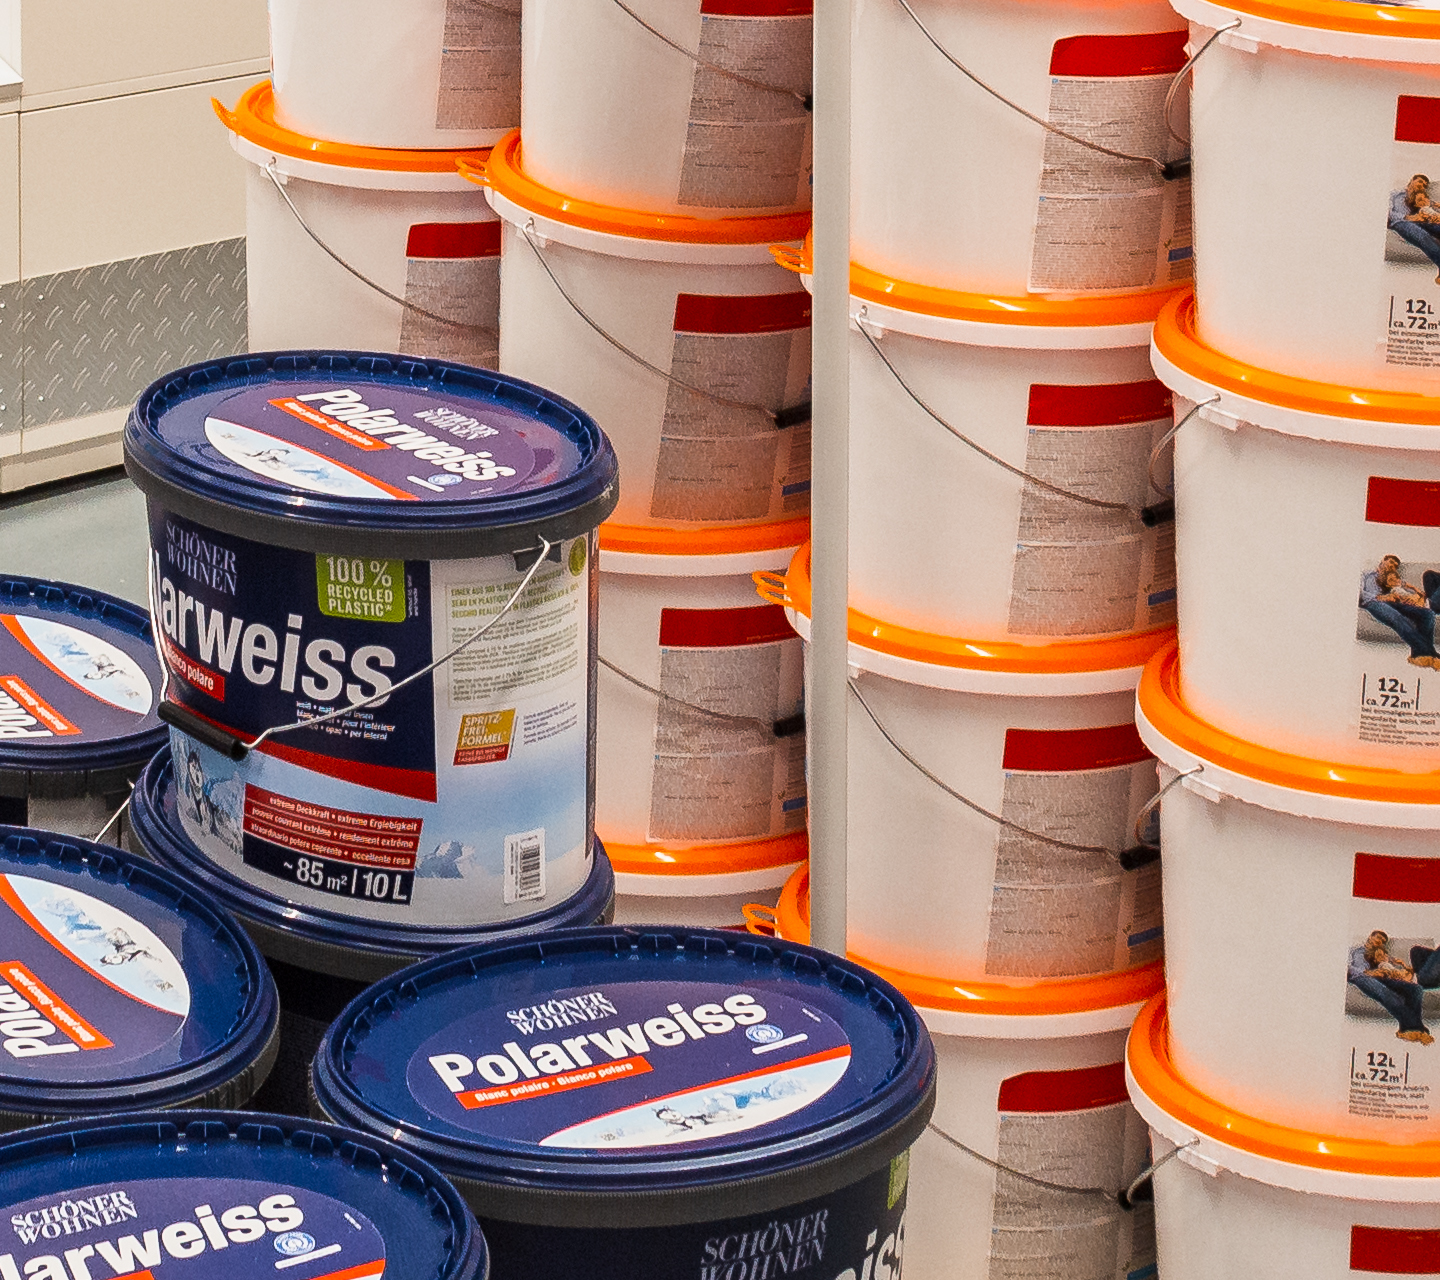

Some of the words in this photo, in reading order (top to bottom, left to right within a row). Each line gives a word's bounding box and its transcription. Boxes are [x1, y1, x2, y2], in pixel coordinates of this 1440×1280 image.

[296, 387, 516, 486] Polarweiss
[325, 555, 364, 585] 100
[327, 584, 393, 603] RECYCLED
[505, 991, 612, 1026] SCHÖNER
[512, 999, 619, 1037] WOHNEN
[426, 992, 769, 1094] Polarweiss
